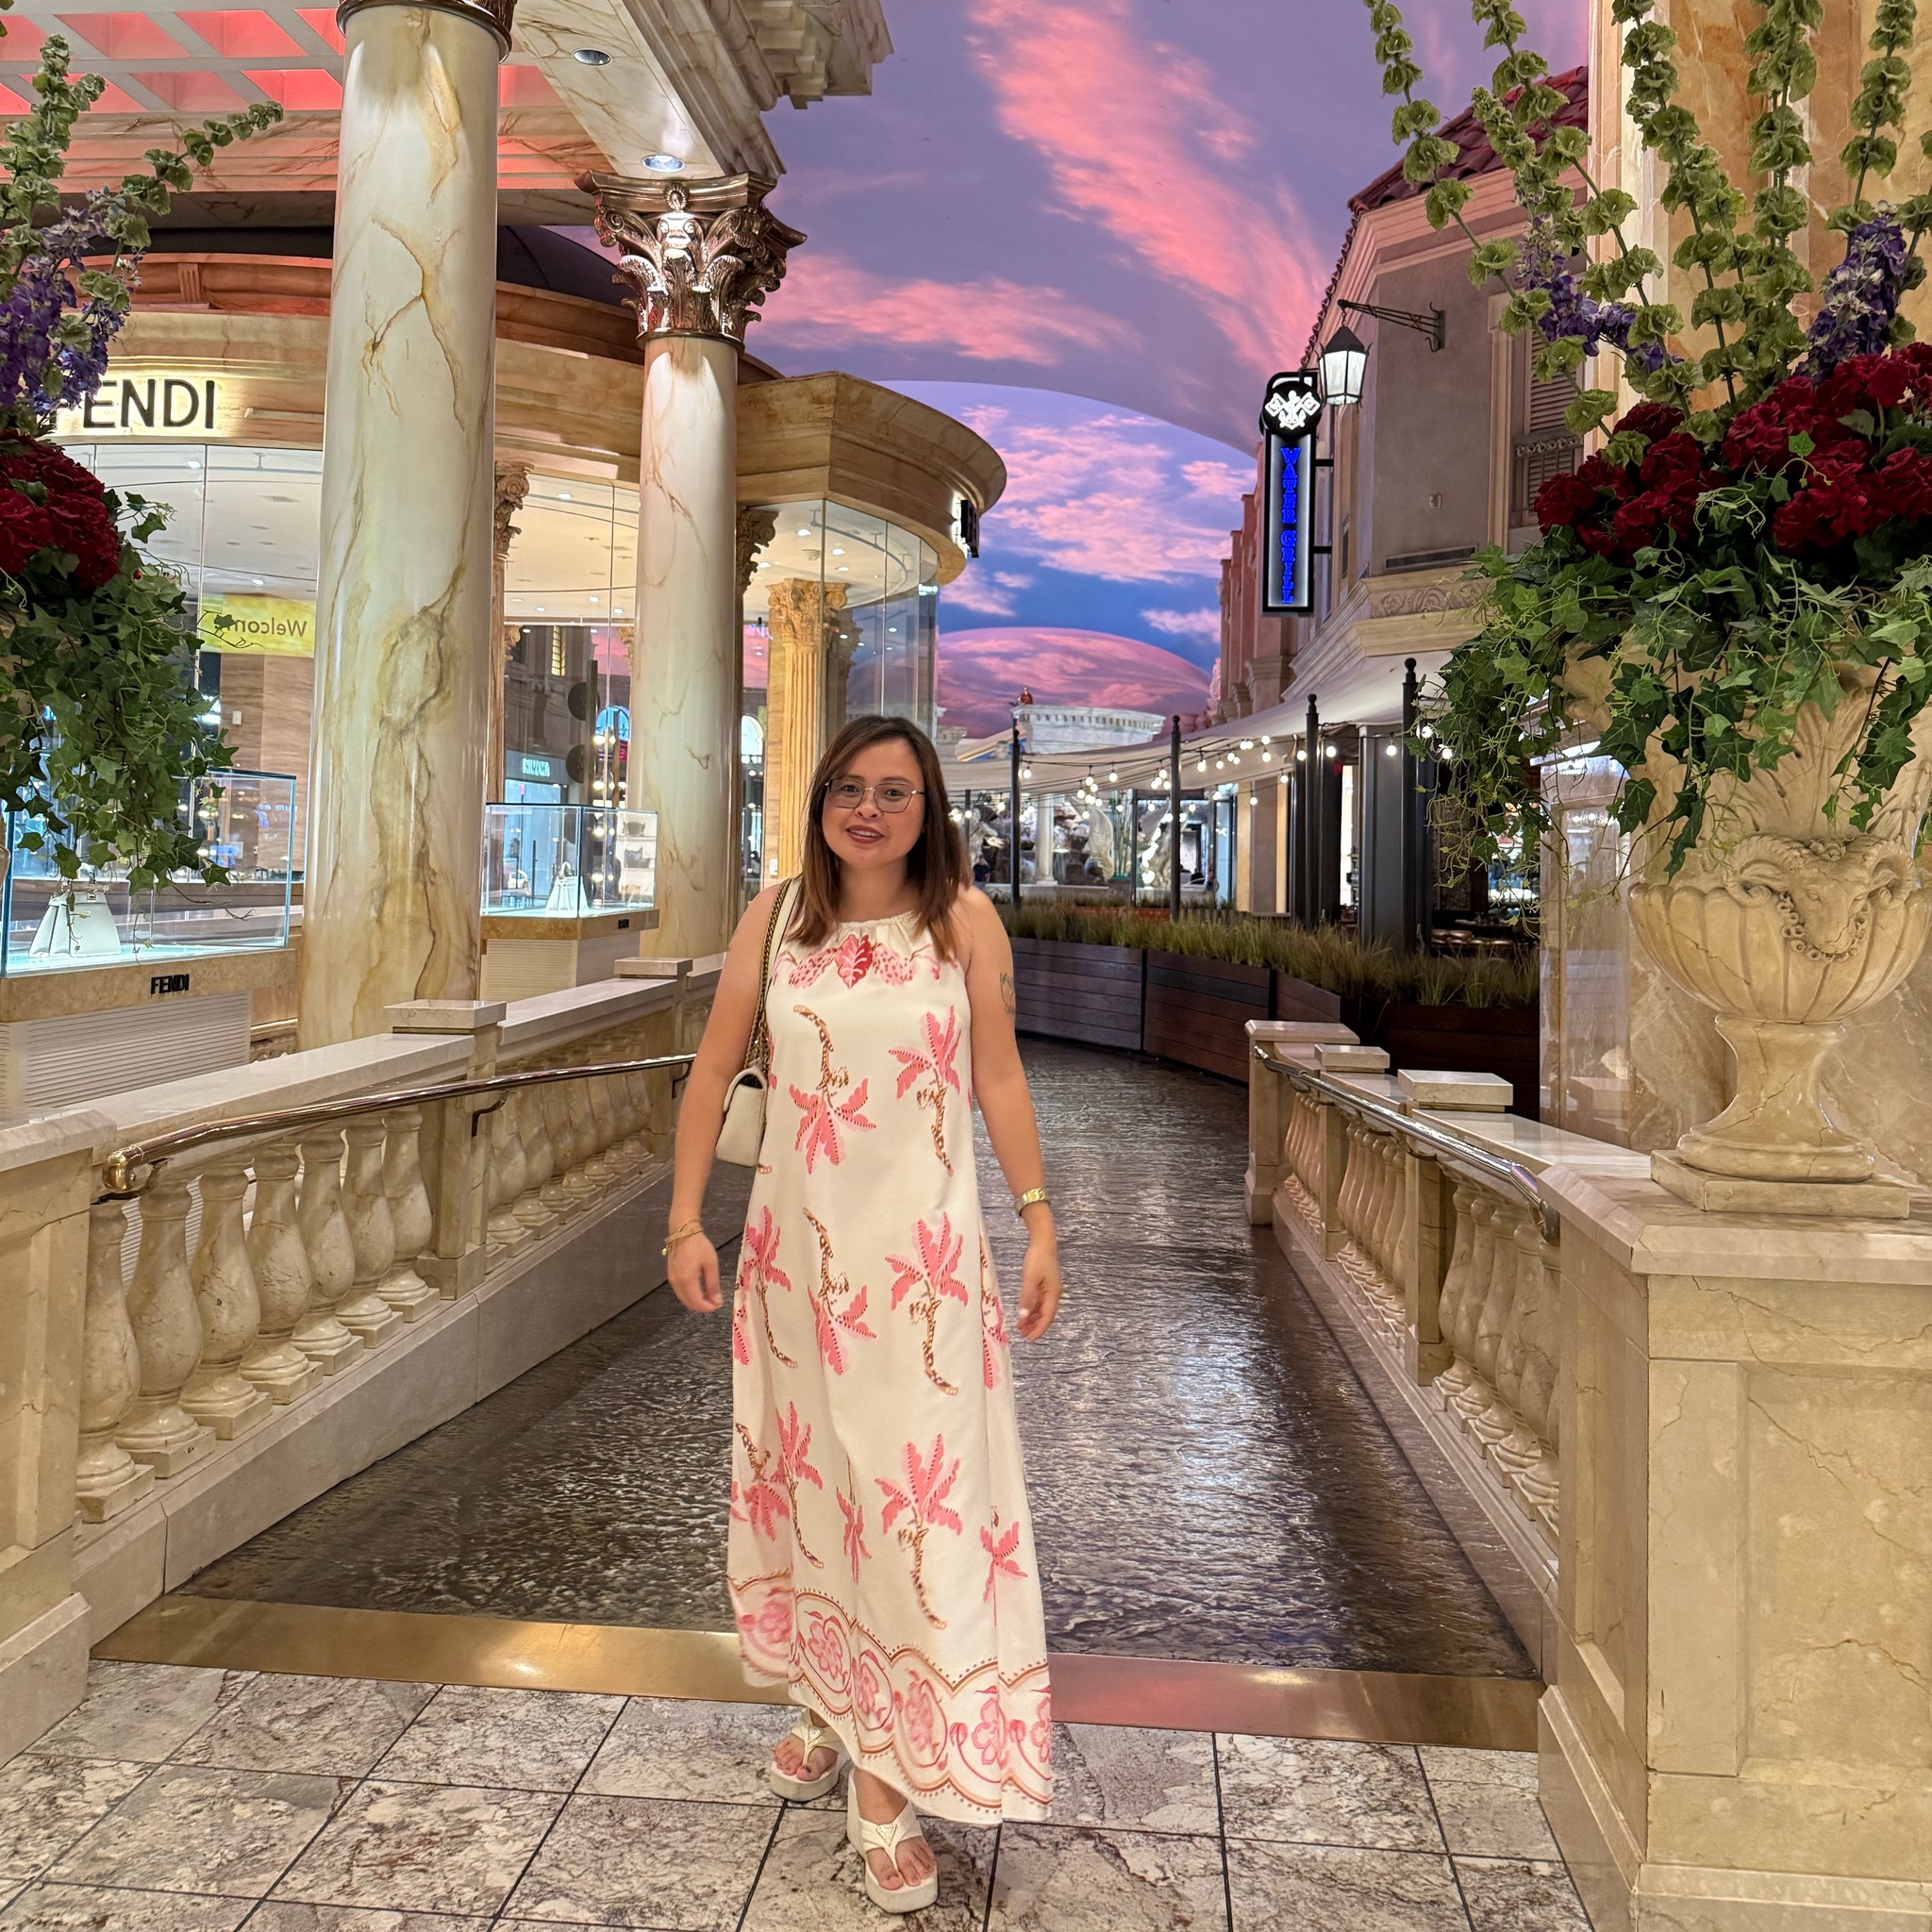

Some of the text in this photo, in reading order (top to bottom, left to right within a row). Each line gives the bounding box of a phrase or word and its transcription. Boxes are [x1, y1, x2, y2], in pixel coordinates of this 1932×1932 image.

[1279, 447, 1302, 604] WATER GRILL
[151, 974, 190, 994] FENDI
